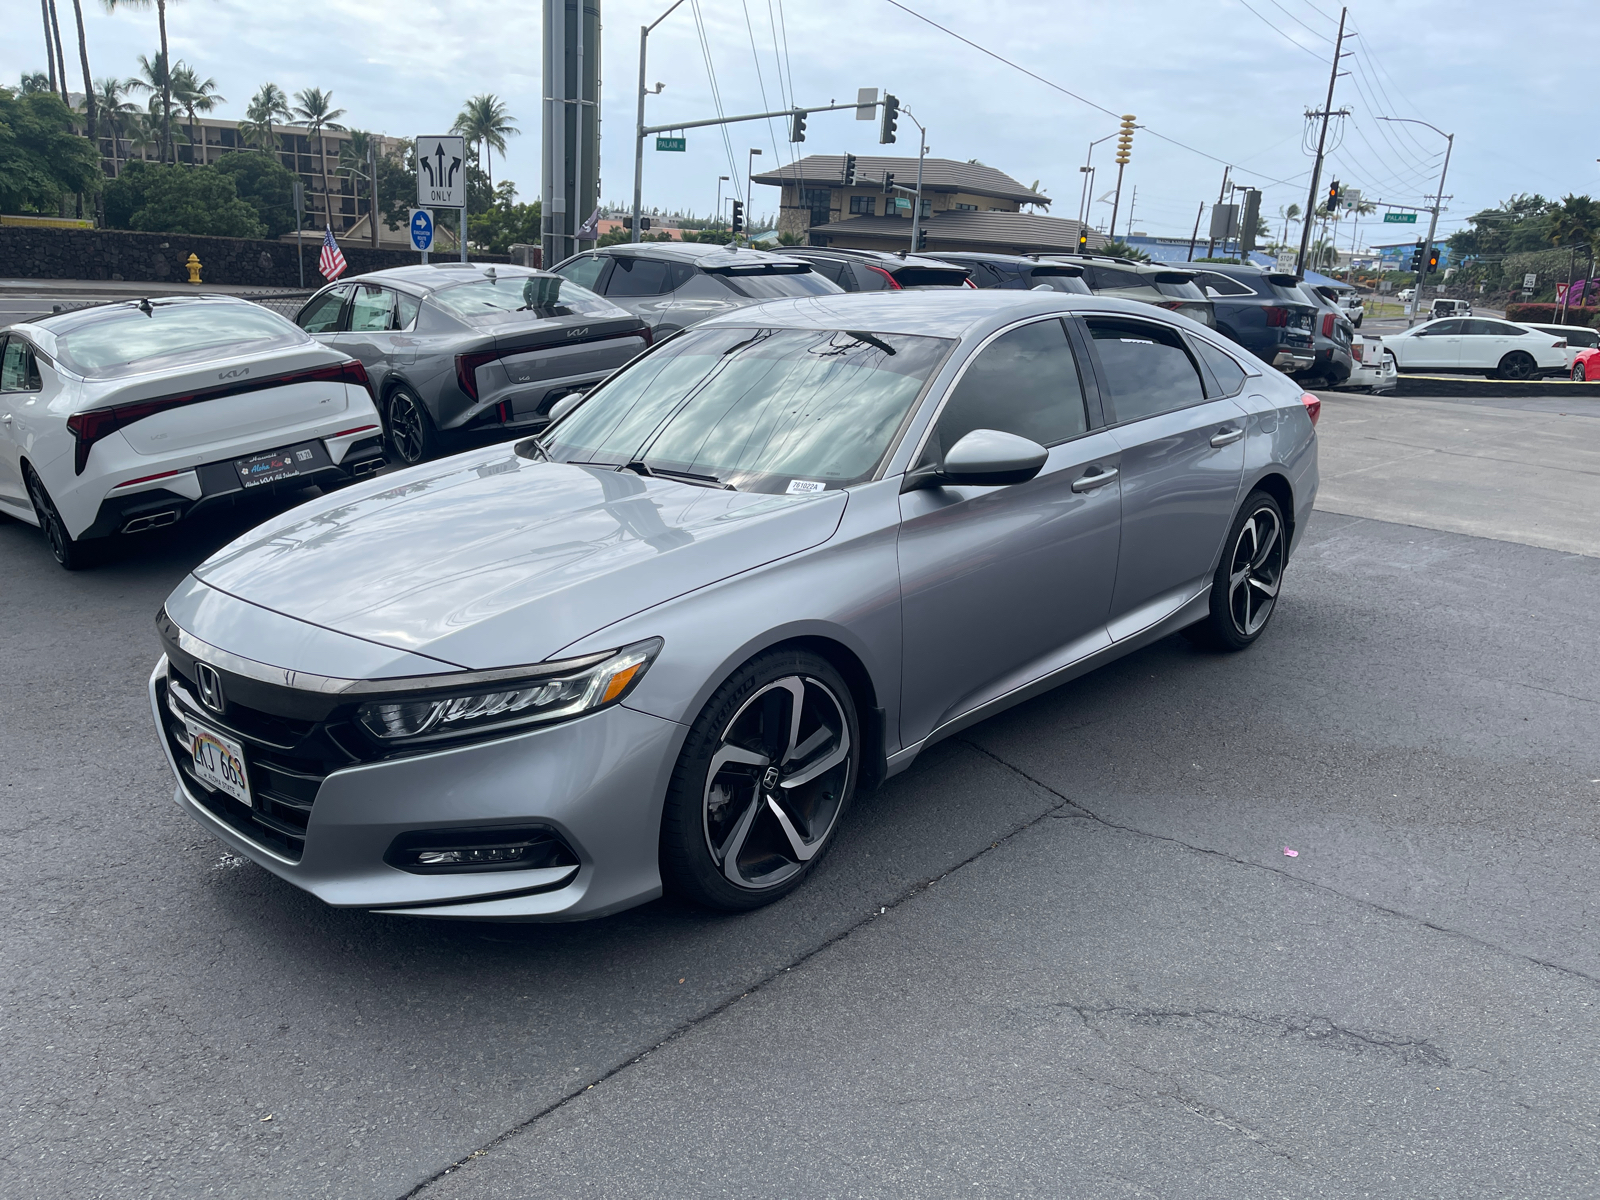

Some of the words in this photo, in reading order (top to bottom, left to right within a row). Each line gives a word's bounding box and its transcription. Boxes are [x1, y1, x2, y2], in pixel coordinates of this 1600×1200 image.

[658, 140, 678, 149] PALANI
[430, 190, 452, 202] ONLY
[1386, 214, 1409, 222] PALANI
[567, 327, 589, 337] KIA
[218, 367, 250, 380] KIA
[250, 462, 271, 473] Aloha
[270, 460, 284, 469] Kia
